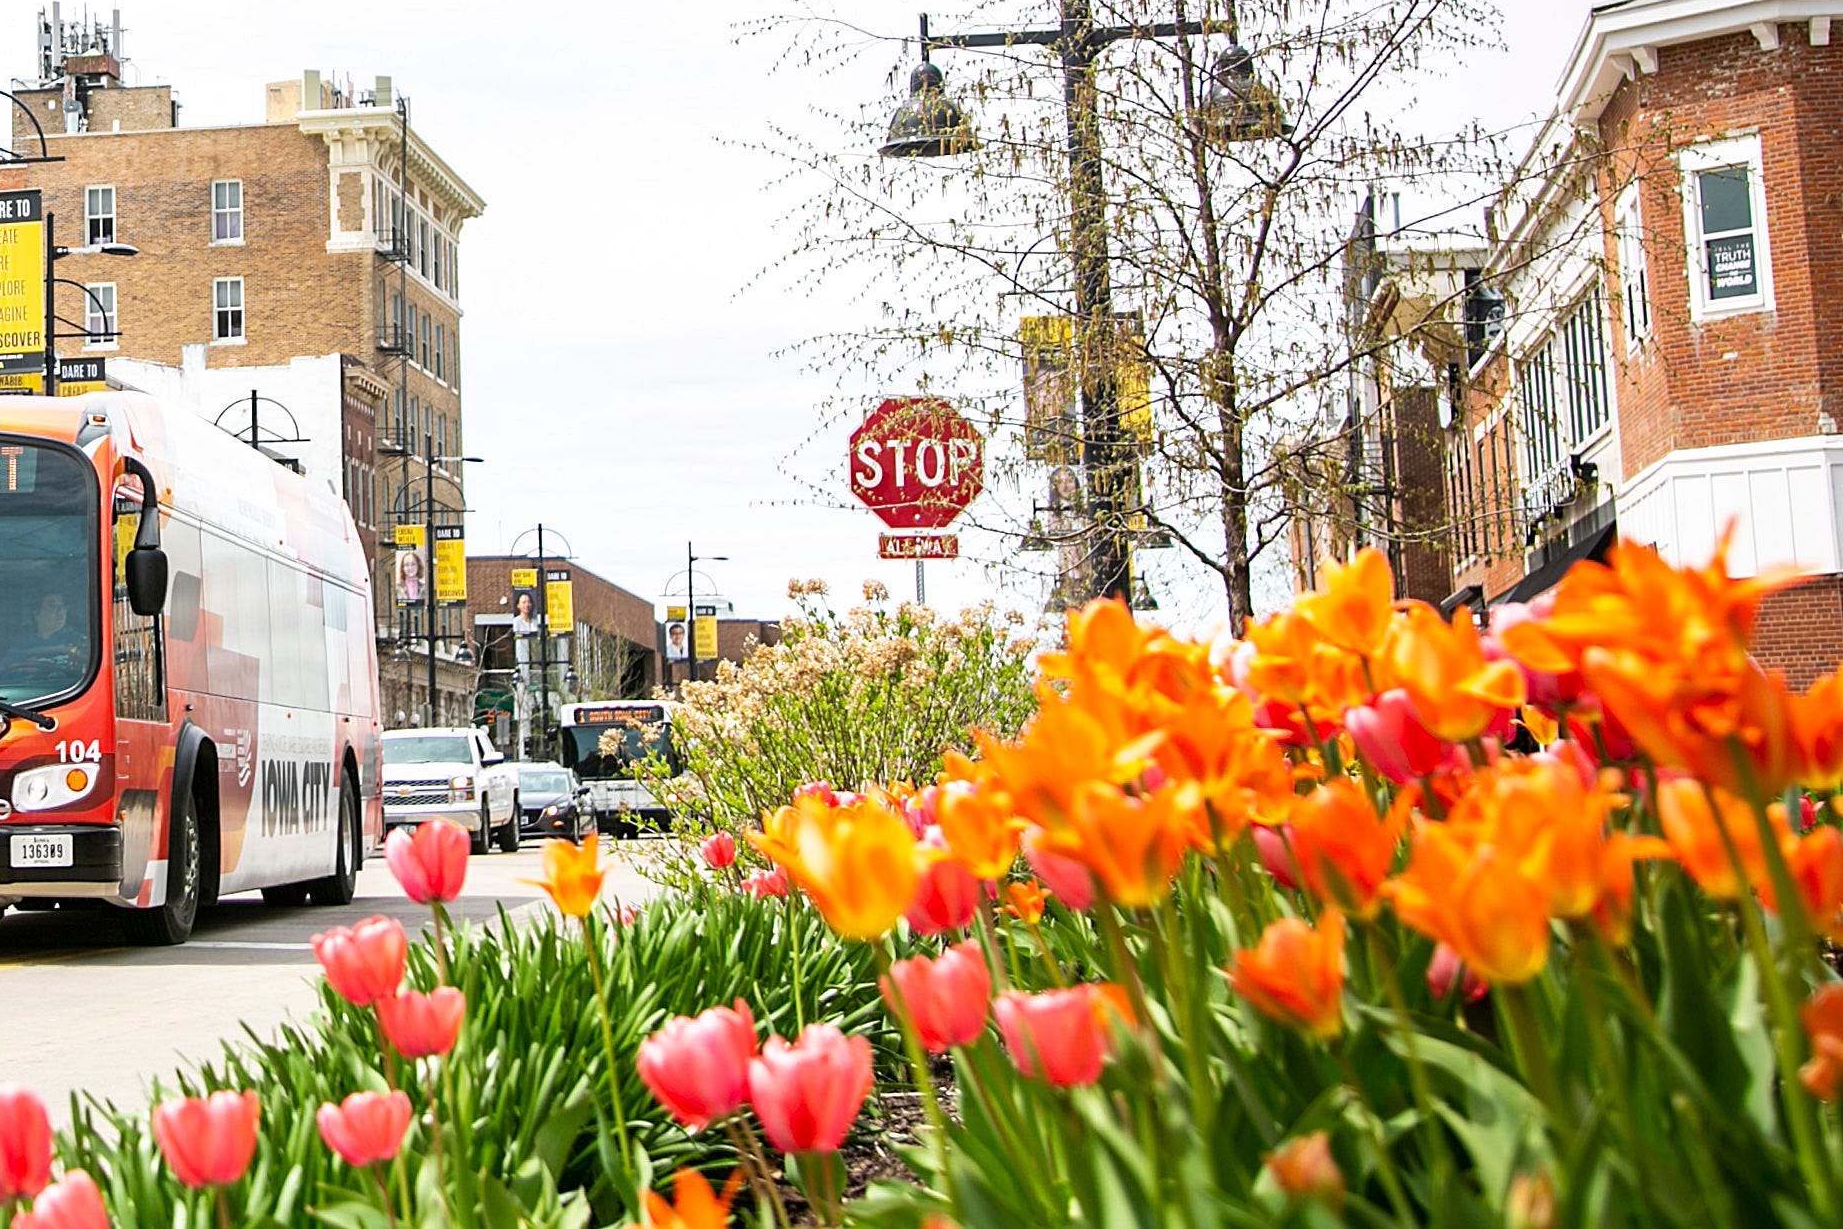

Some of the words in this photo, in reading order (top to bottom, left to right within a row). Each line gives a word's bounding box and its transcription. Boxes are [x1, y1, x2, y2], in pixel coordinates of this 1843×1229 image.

[16, 199, 31, 217] TO
[1714, 249, 1751, 263] TRUTH
[1716, 274, 1753, 288] WORLD
[62, 365, 84, 379] DARE
[87, 364, 98, 378] TO
[855, 438, 978, 488] STOP
[55, 739, 102, 764] 104
[261, 758, 300, 838] IOWA
[302, 760, 331, 836] CITY
[22, 844, 63, 859] 136309
